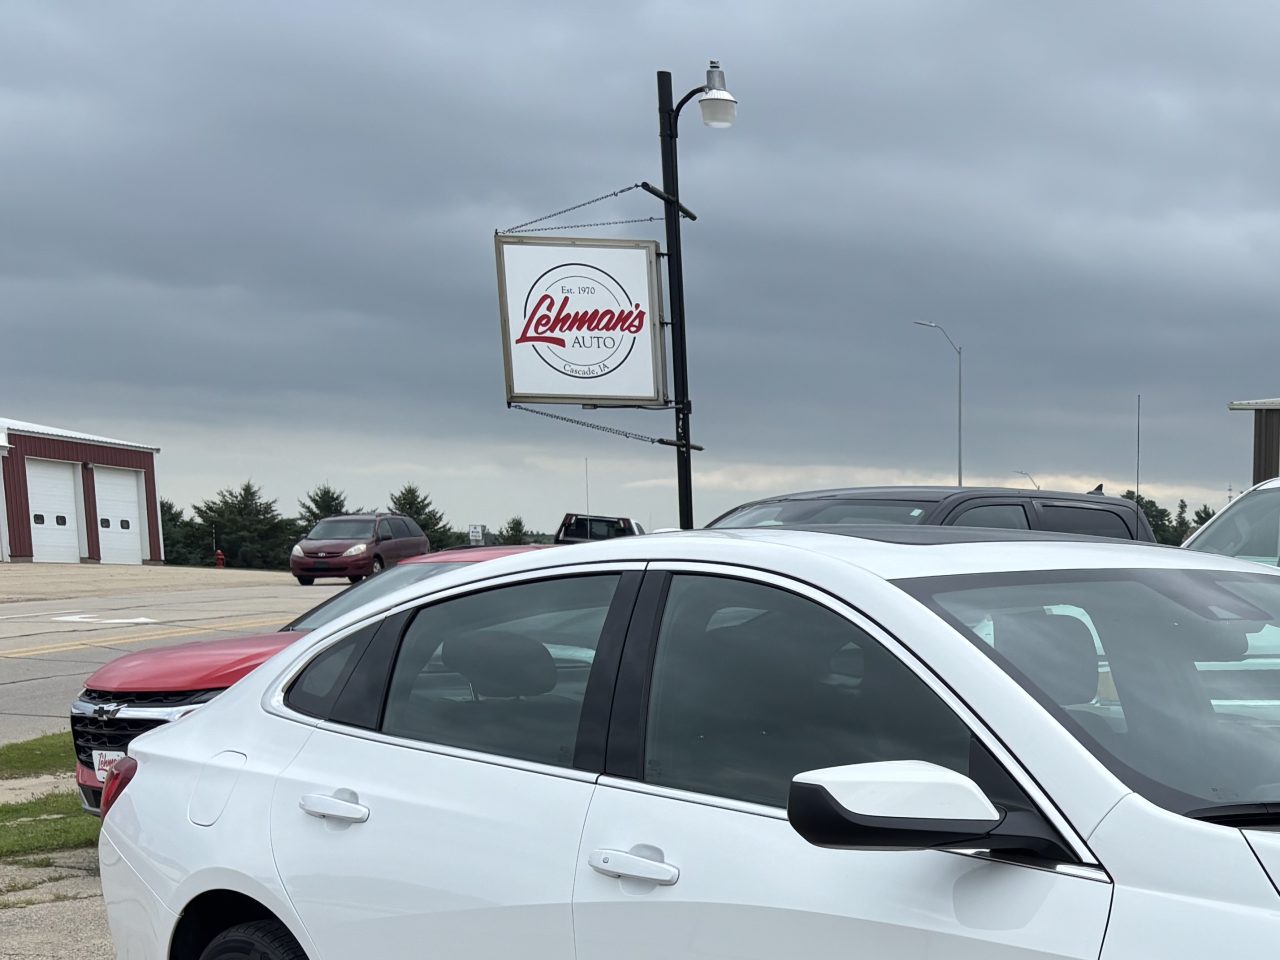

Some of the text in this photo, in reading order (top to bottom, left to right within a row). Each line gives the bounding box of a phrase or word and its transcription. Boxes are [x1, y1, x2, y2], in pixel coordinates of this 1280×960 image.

[561, 286, 596, 295] Est. 1970
[515, 293, 647, 349] Lehman's
[572, 336, 616, 349] AUTO
[563, 363, 610, 376] Cascade, IA
